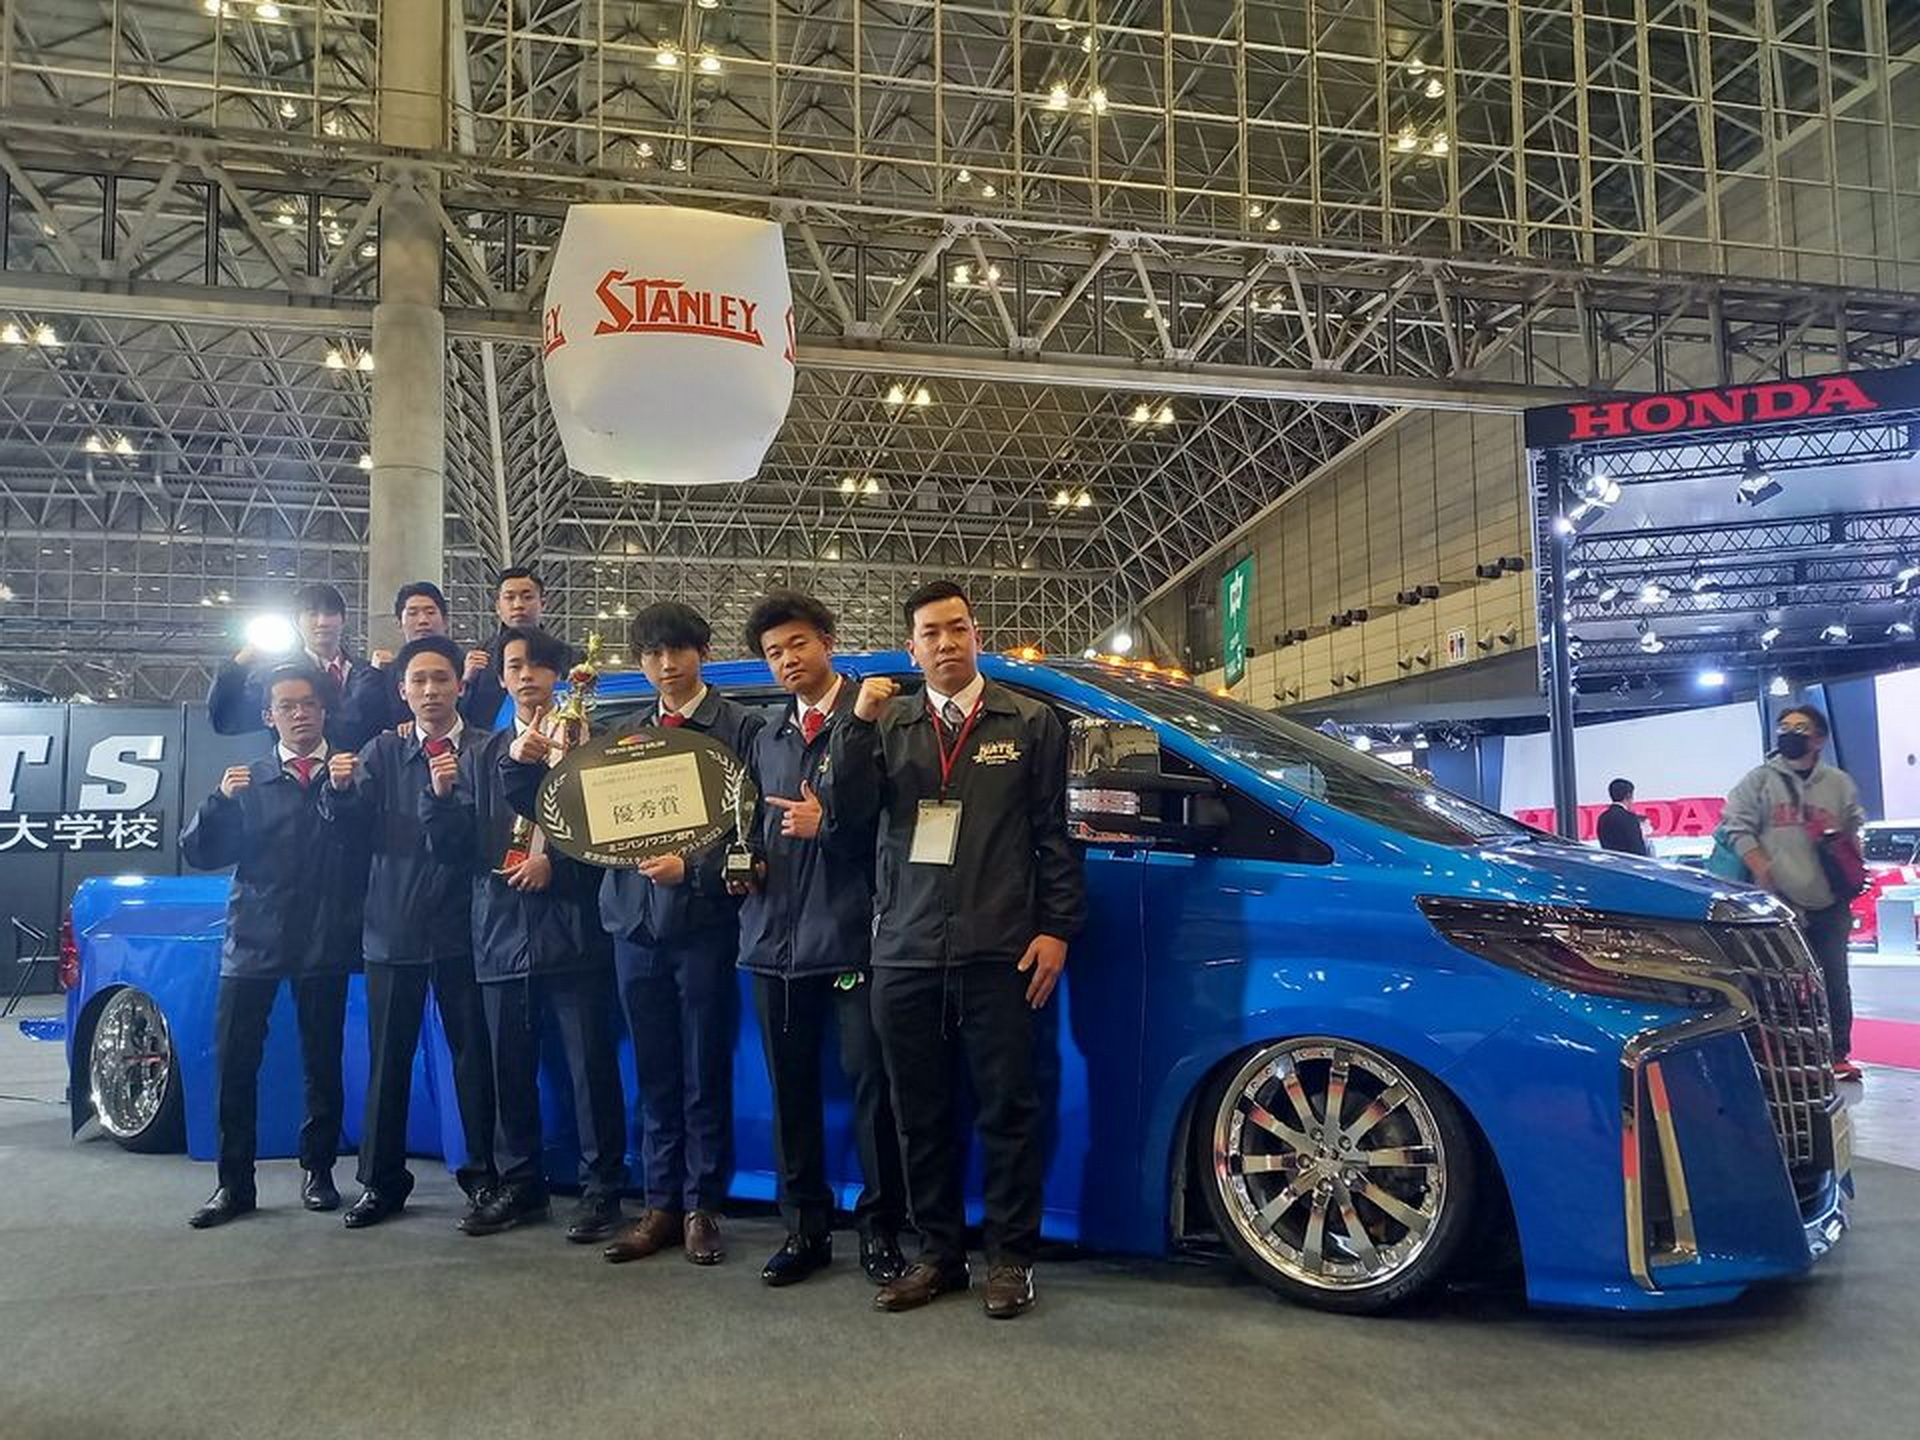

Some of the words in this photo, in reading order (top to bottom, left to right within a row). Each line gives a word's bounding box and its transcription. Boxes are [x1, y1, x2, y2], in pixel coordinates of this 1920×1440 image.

[594, 270, 760, 339] STANLEY
[1569, 377, 1877, 440] HONDA
[612, 795, 681, 825] 優秀賞
